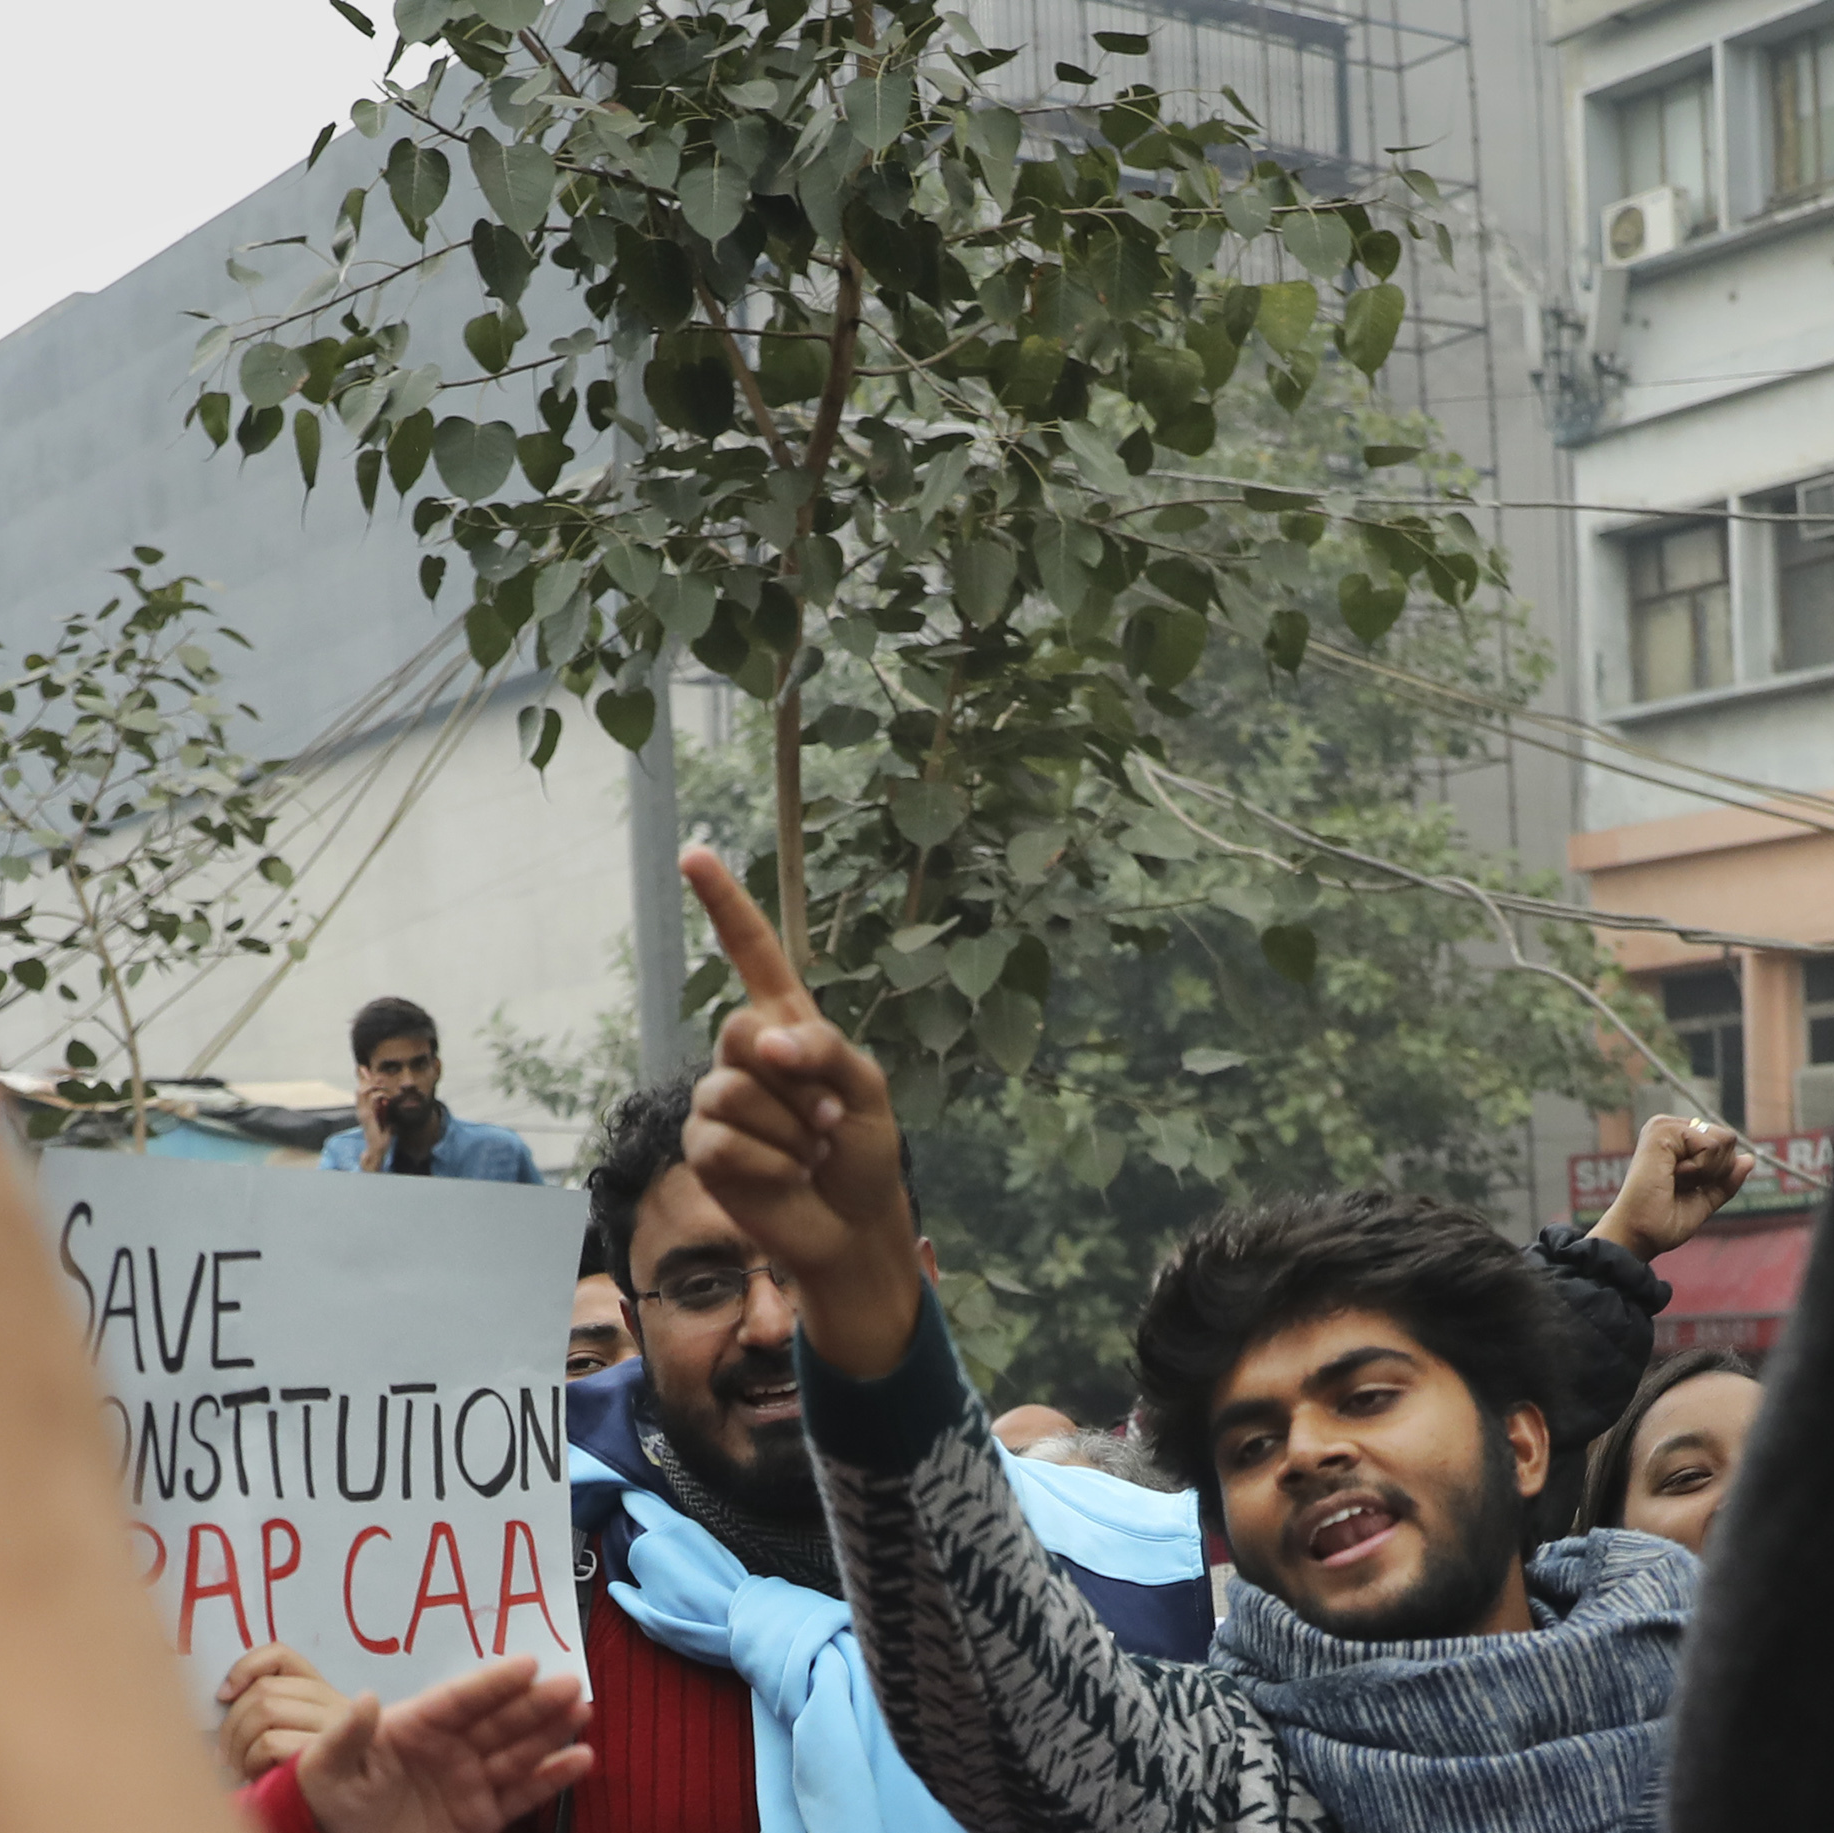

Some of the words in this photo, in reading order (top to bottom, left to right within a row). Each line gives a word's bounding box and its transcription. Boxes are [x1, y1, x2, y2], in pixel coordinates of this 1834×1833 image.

[59, 1200, 262, 1374] SAVE
[101, 1384, 565, 1506] NSTITUTION
[343, 1518, 571, 1660] CAA
